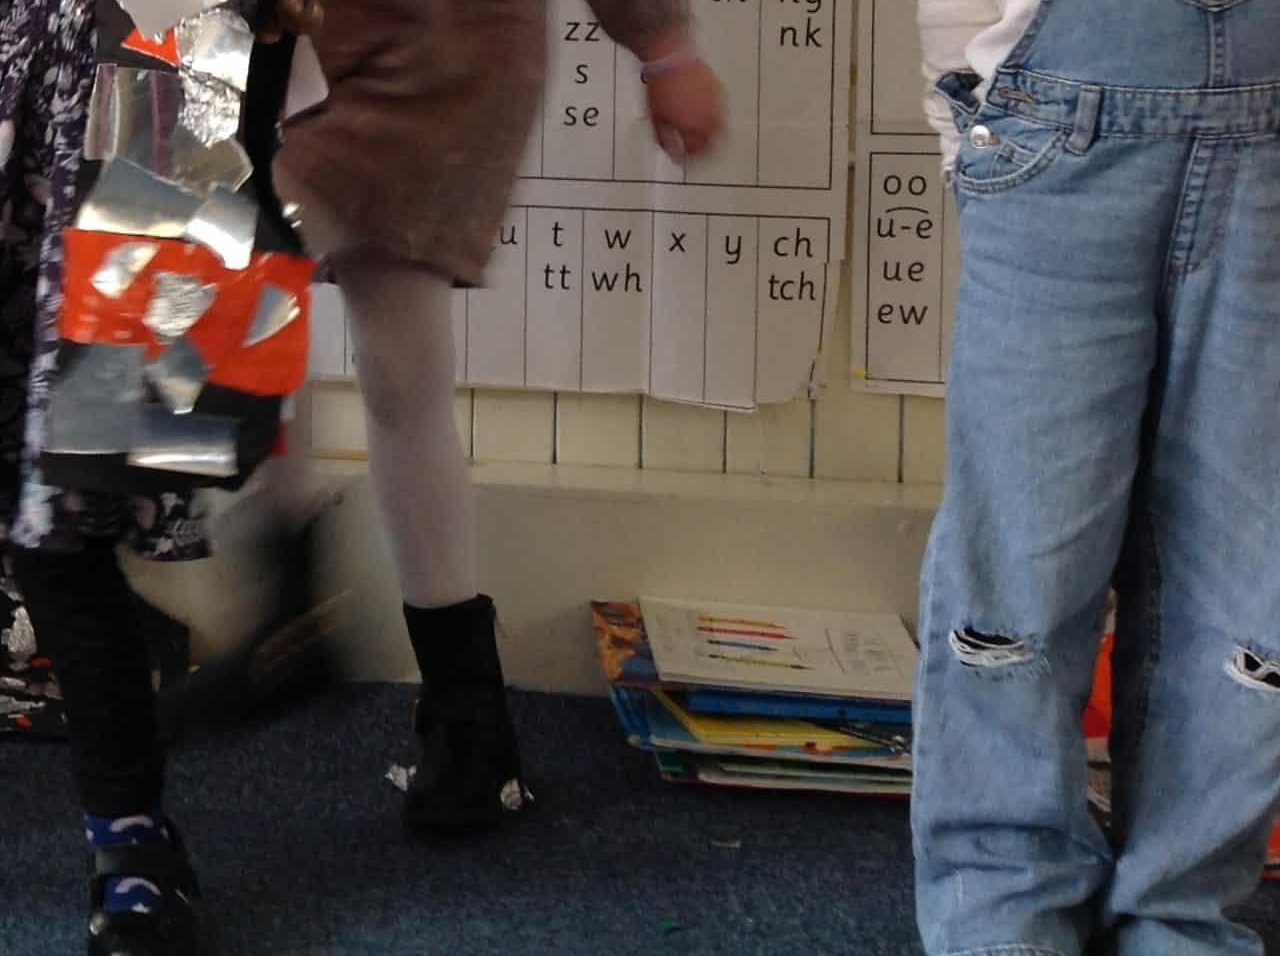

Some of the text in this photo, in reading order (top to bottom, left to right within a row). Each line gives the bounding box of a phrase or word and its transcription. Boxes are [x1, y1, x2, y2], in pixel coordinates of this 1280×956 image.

[564, 21, 600, 42] zz
[779, 17, 823, 47] nk
[574, 64, 589, 84] s
[563, 105, 600, 126] se
[883, 174, 927, 196] oo
[552, 222, 564, 247] t
[604, 229, 632, 250] w
[876, 216, 933, 240] u-e
[669, 232, 686, 252] x
[725, 235, 742, 264] y
[773, 228, 813, 257] ch
[544, 264, 571, 290] tt
[592, 263, 642, 292] wh
[883, 260, 925, 283] ue
[768, 271, 816, 301] tch
[877, 303, 929, 325] ew
